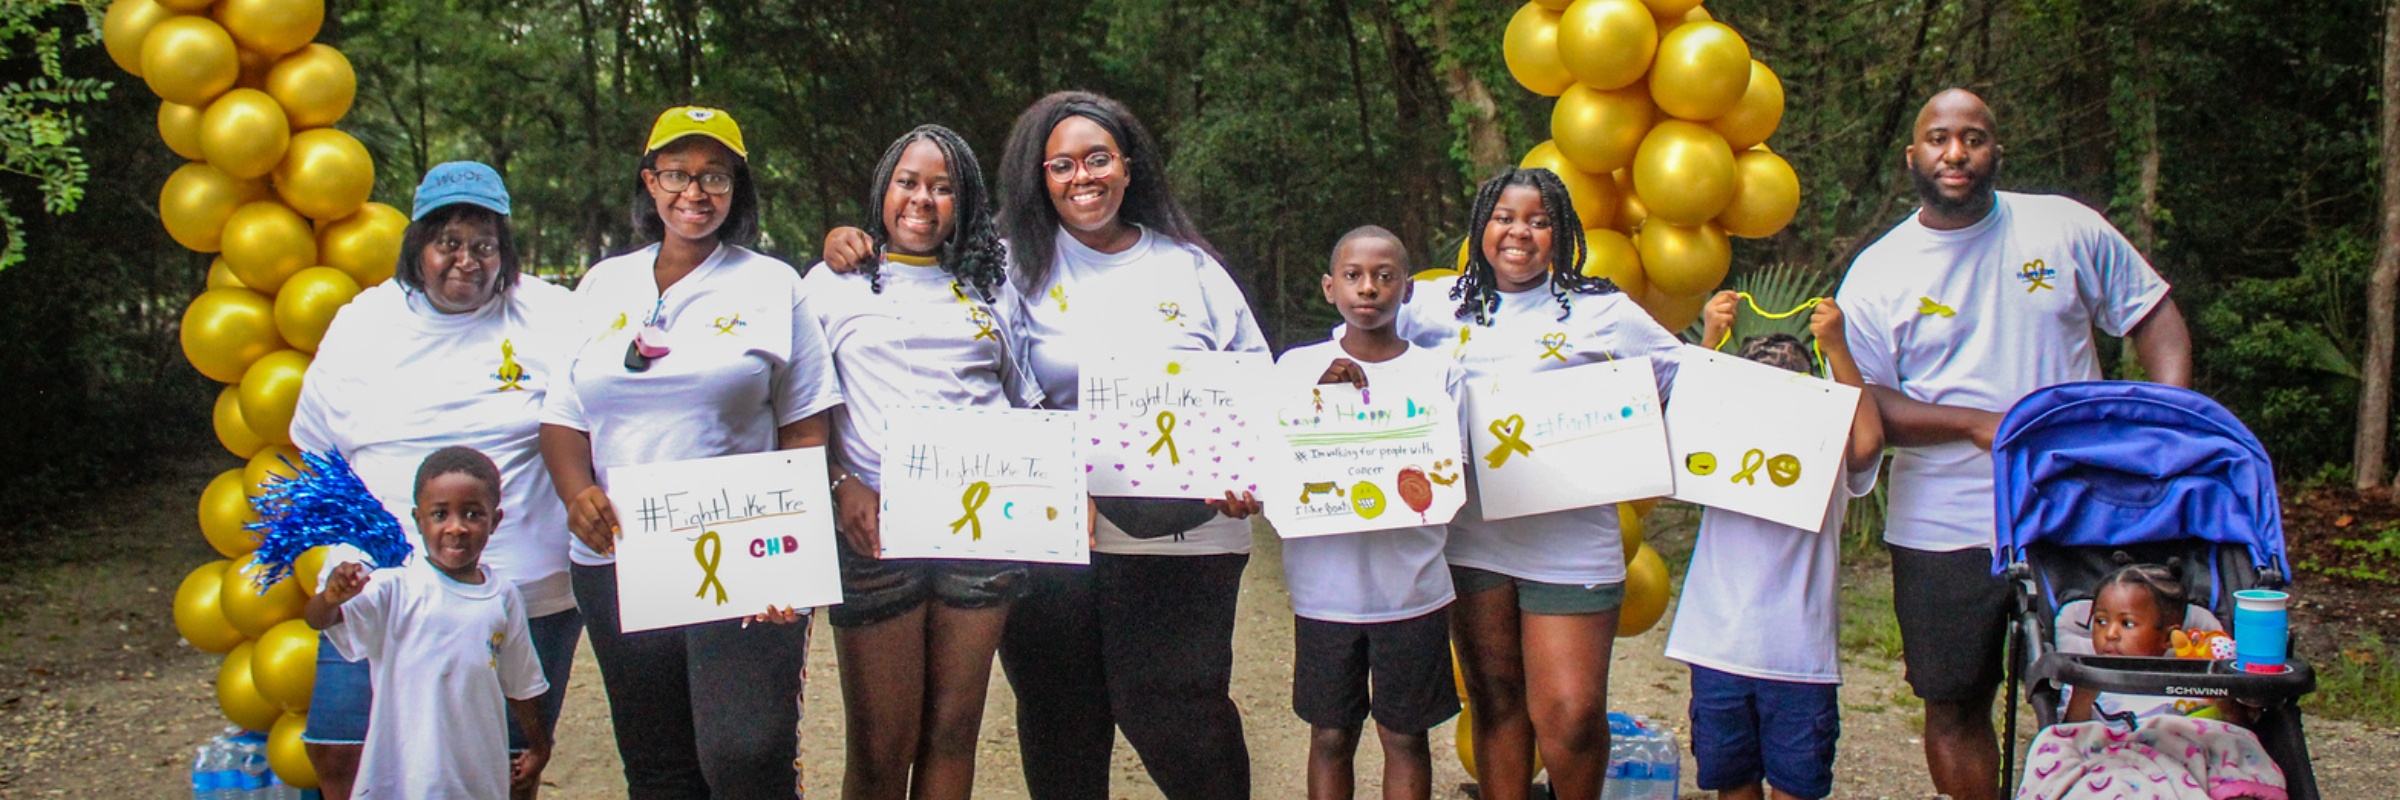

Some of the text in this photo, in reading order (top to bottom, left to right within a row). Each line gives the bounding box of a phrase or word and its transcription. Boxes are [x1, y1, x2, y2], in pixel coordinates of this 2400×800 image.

[1335, 403, 1391, 426] Happy
[1359, 446, 1377, 457] for
[1379, 445, 1407, 459] people
[1410, 442, 1434, 455] with
[749, 535, 799, 558] CHD
[2165, 686, 2229, 696] SCHWINN
